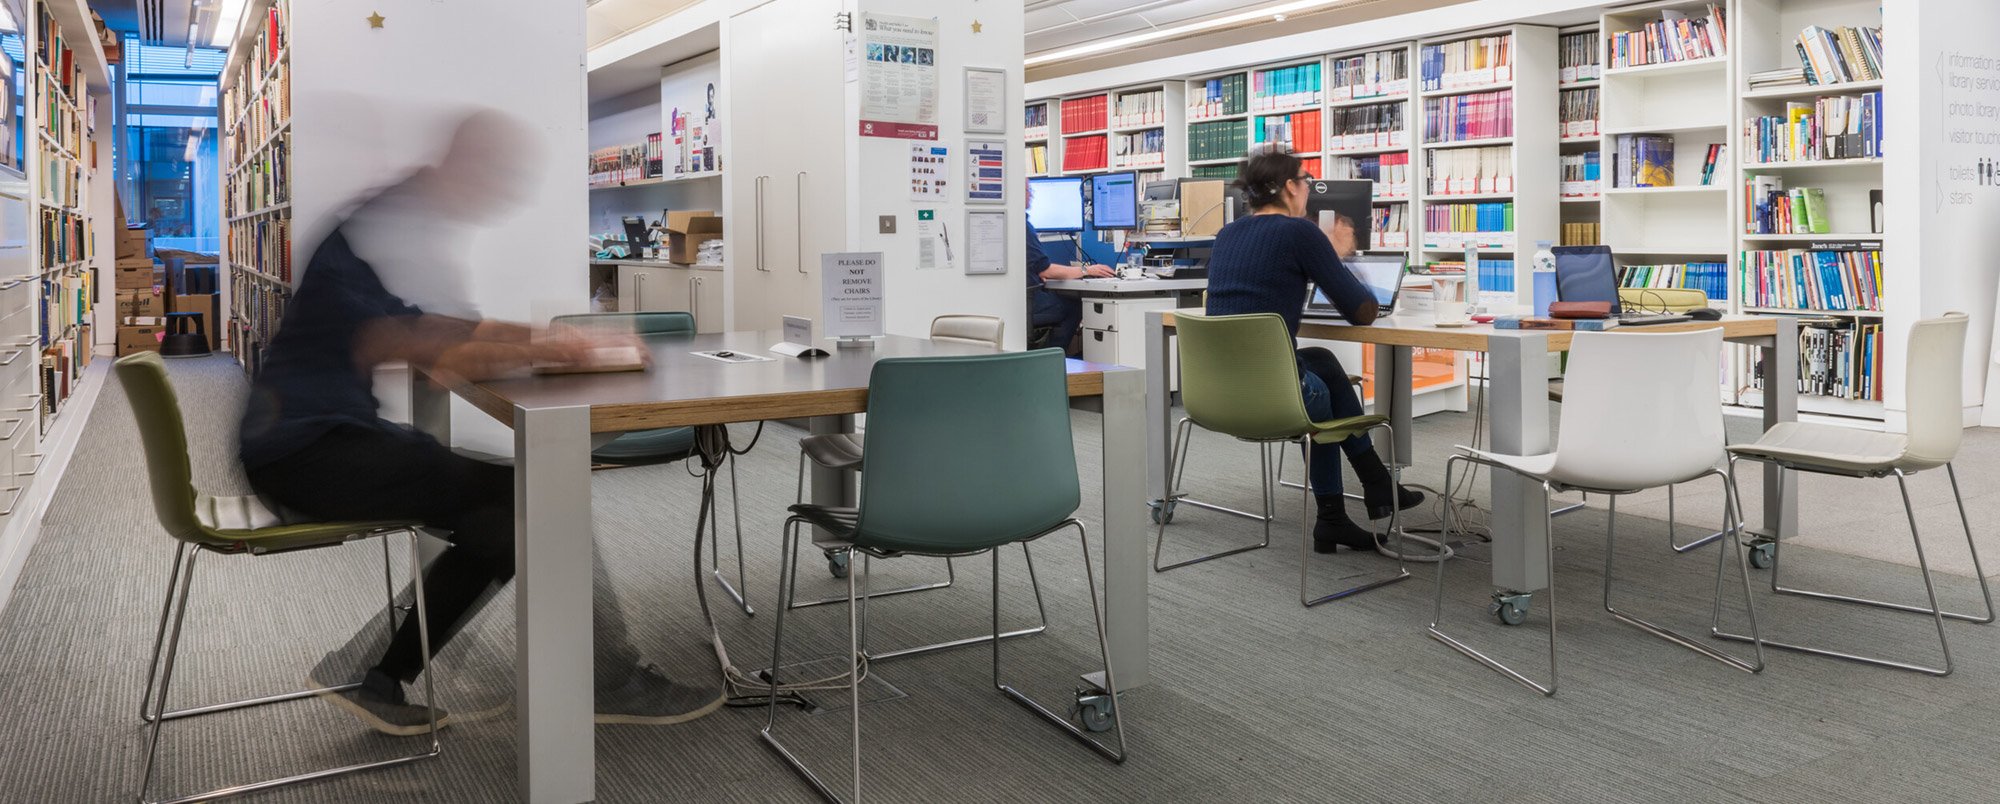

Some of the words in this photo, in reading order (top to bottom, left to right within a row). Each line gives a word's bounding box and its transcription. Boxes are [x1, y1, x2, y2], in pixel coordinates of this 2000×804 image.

[1948, 51, 1994, 70] information
[1949, 72, 1974, 92] library
[1949, 101, 1974, 118] photo
[1949, 129, 1973, 144] visitor
[1975, 130, 2000, 145] touch
[1950, 165, 1975, 181] toilets
[1950, 190, 1973, 205] stairs
